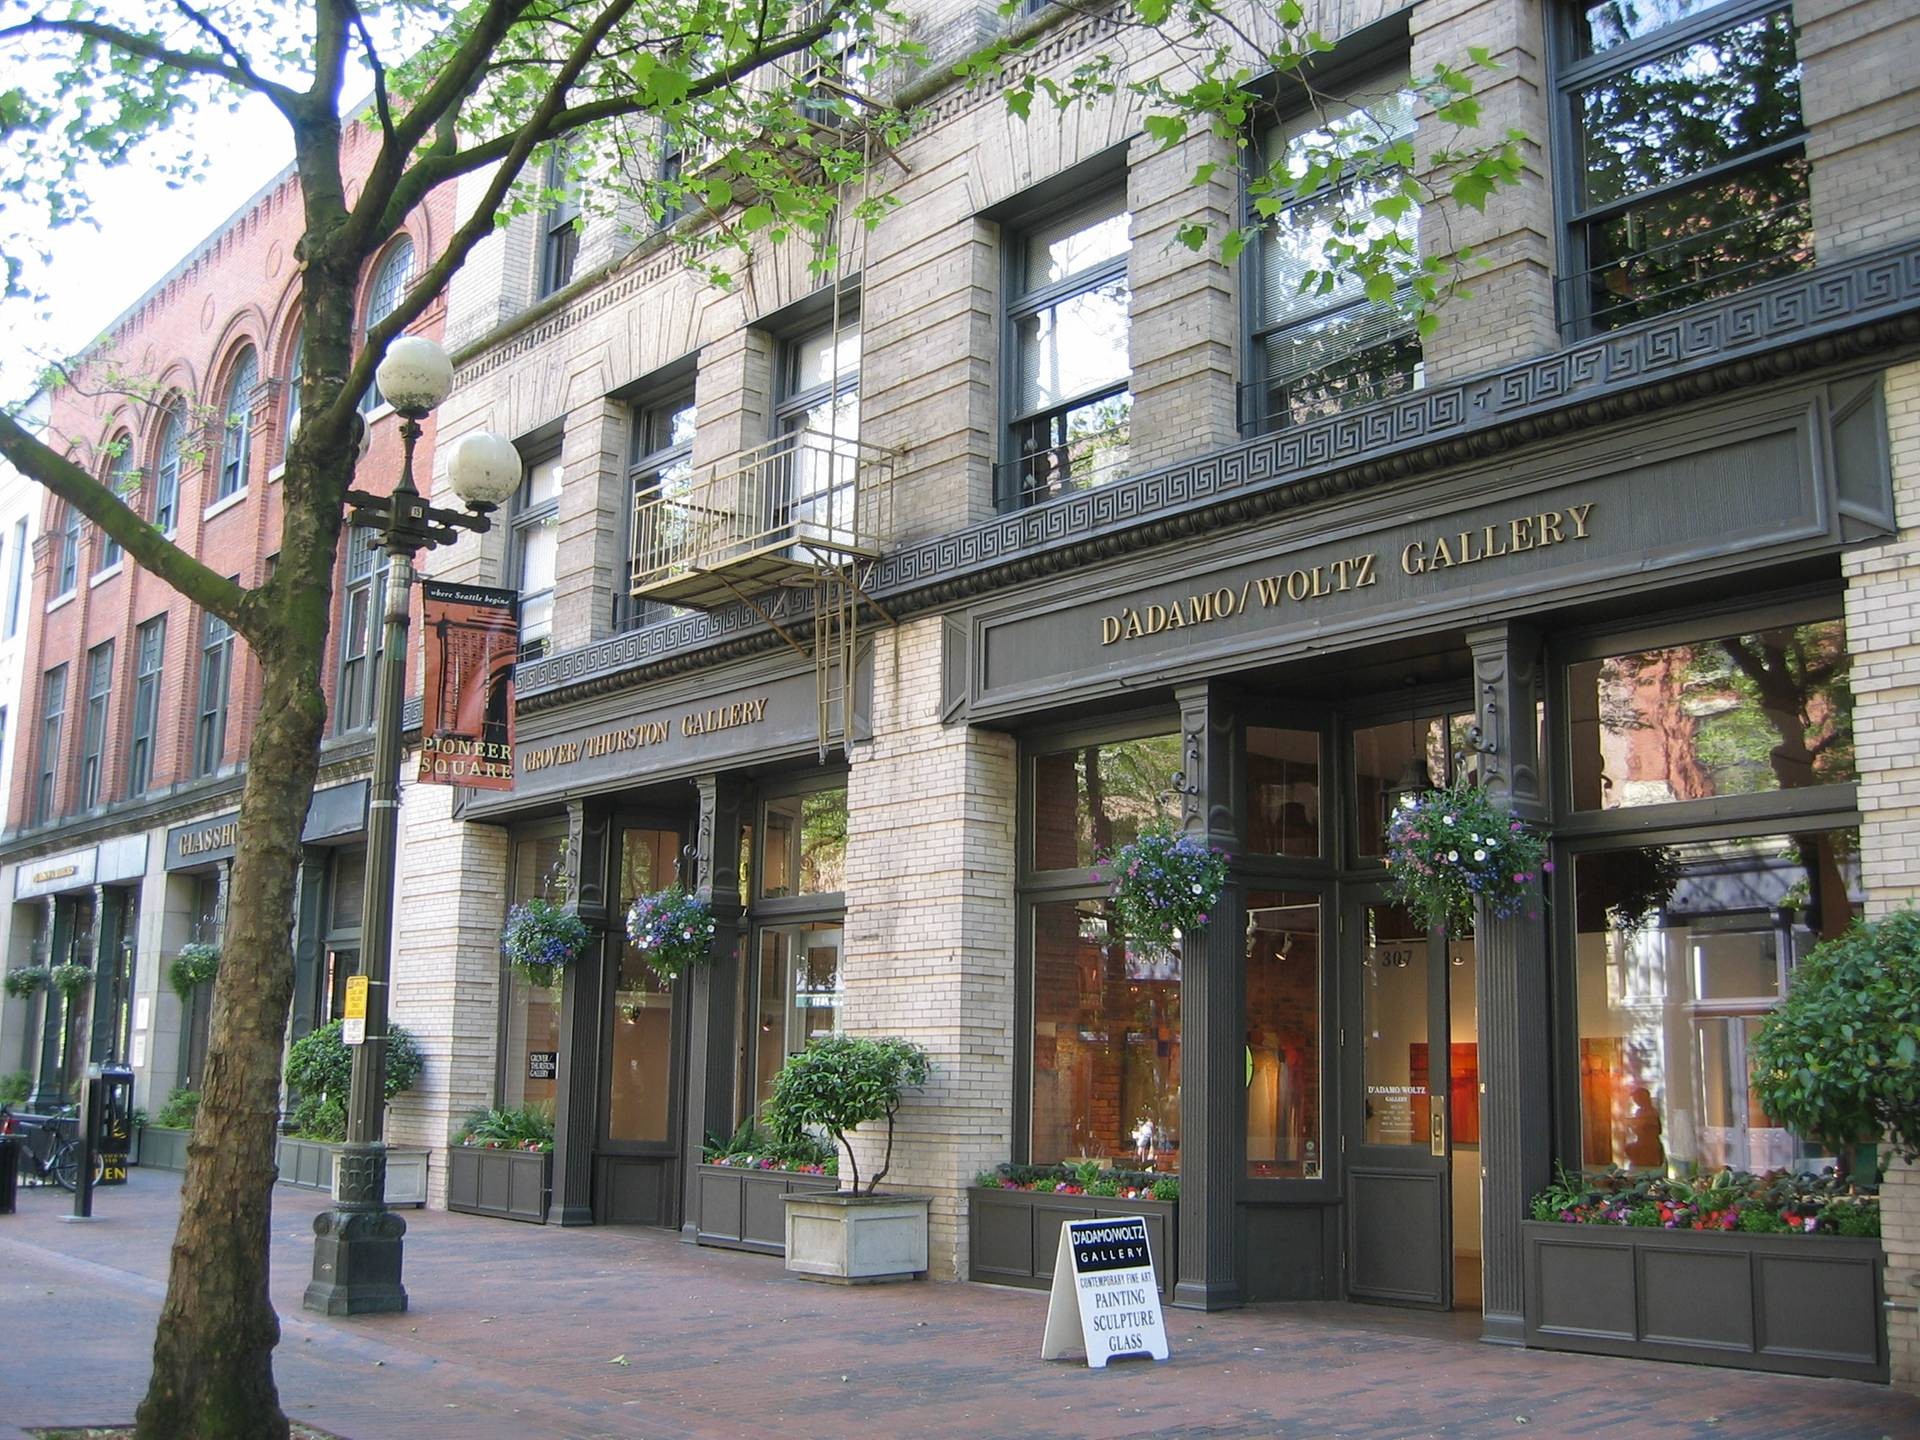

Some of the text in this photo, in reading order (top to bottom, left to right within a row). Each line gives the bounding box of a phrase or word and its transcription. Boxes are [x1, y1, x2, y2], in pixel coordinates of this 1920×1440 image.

[1100, 502, 1597, 646] D'ADAMO/WOLTZ GALLERY
[431, 589, 510, 605] where Seattle begins
[681, 697, 769, 738] GALLERY
[422, 736, 513, 761] PIONEER
[421, 757, 514, 780] SQUARE
[1382, 950, 1412, 968] 307
[1072, 1226, 1144, 1245] D'ADAMO/WOLTZ
[1081, 1247, 1142, 1262] GALLERY
[1080, 1274, 1125, 1288] CONTEMPORARY
[1126, 1272, 1139, 1285] FINE
[1095, 1288, 1146, 1309] PAINTING
[1093, 1310, 1155, 1332] SCULPTURE
[1109, 1333, 1142, 1352] GLASS
